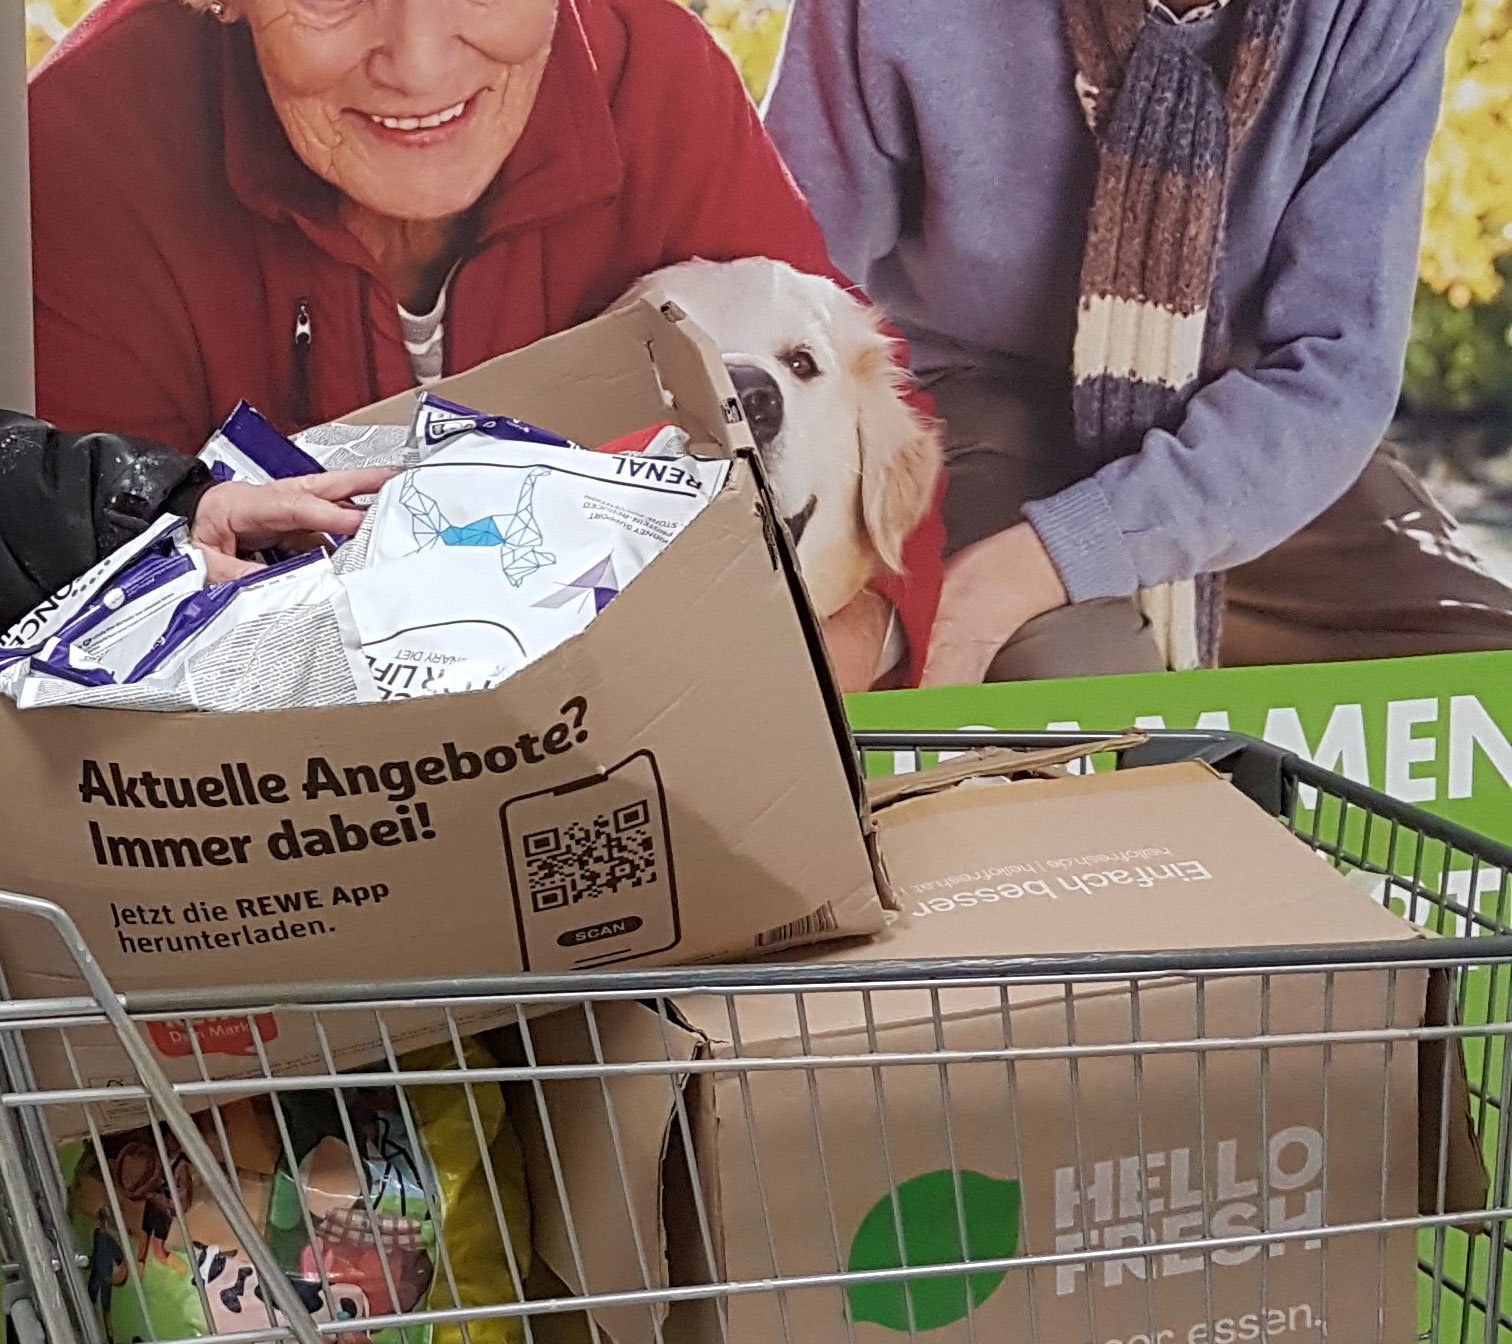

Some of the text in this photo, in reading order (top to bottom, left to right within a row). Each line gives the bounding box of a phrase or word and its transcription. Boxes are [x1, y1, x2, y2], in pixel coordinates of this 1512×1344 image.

[611, 456, 702, 490] RENAL
[395, 649, 424, 661] DIET
[79, 695, 589, 809] Aktuelle Angebote?
[88, 802, 437, 869] Immer dabei!
[1057, 860, 1213, 896] Einfach
[110, 880, 390, 929] Jetzt die REWE App
[912, 879, 1058, 918] besser
[118, 917, 336, 955] herunterladen.
[574, 920, 626, 942] SCAN
[1055, 1126, 1324, 1229] HELLO
[1055, 1190, 1323, 1297] FRESH
